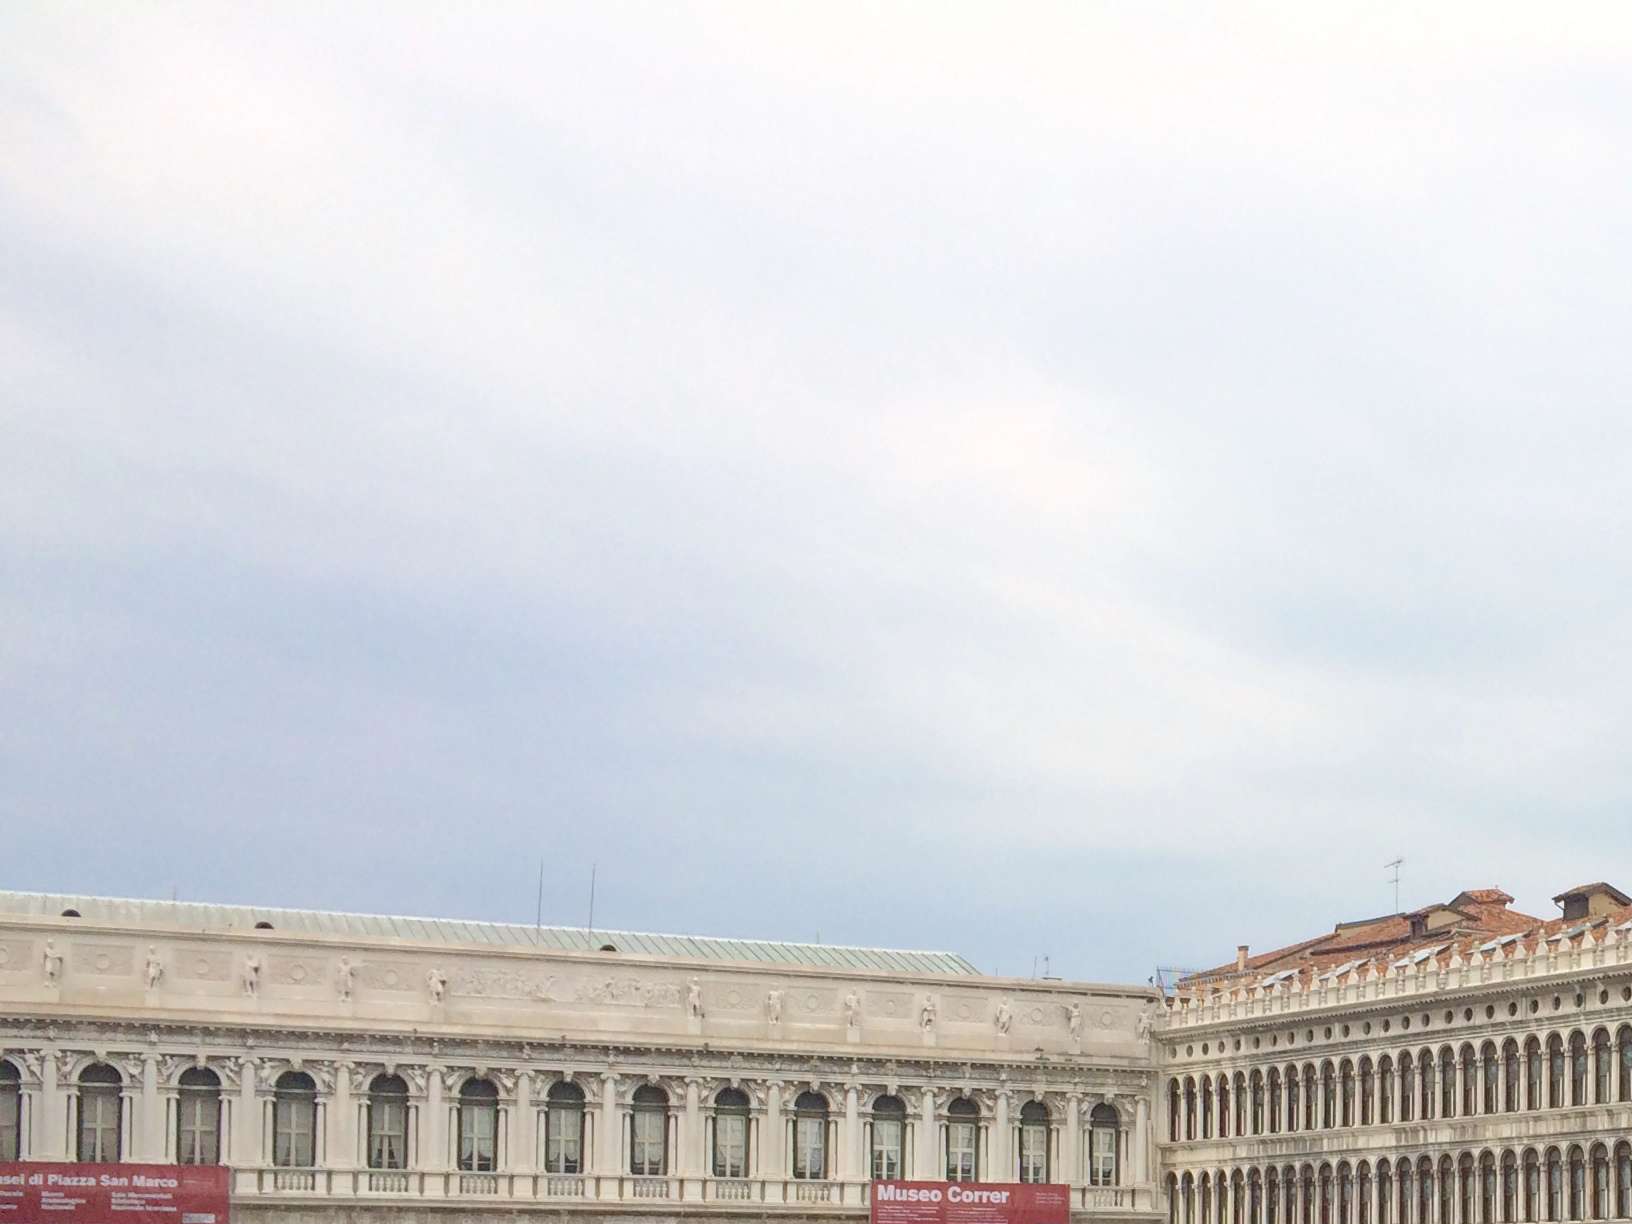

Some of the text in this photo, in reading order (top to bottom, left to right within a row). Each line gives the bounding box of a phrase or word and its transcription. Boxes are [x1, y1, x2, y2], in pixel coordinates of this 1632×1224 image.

[29, 1174, 43, 1185] di
[47, 1174, 97, 1186] Piazza
[100, 1175, 129, 1187] San
[132, 1175, 178, 1188] Marco
[877, 1184, 1010, 1203] Museo Correr
